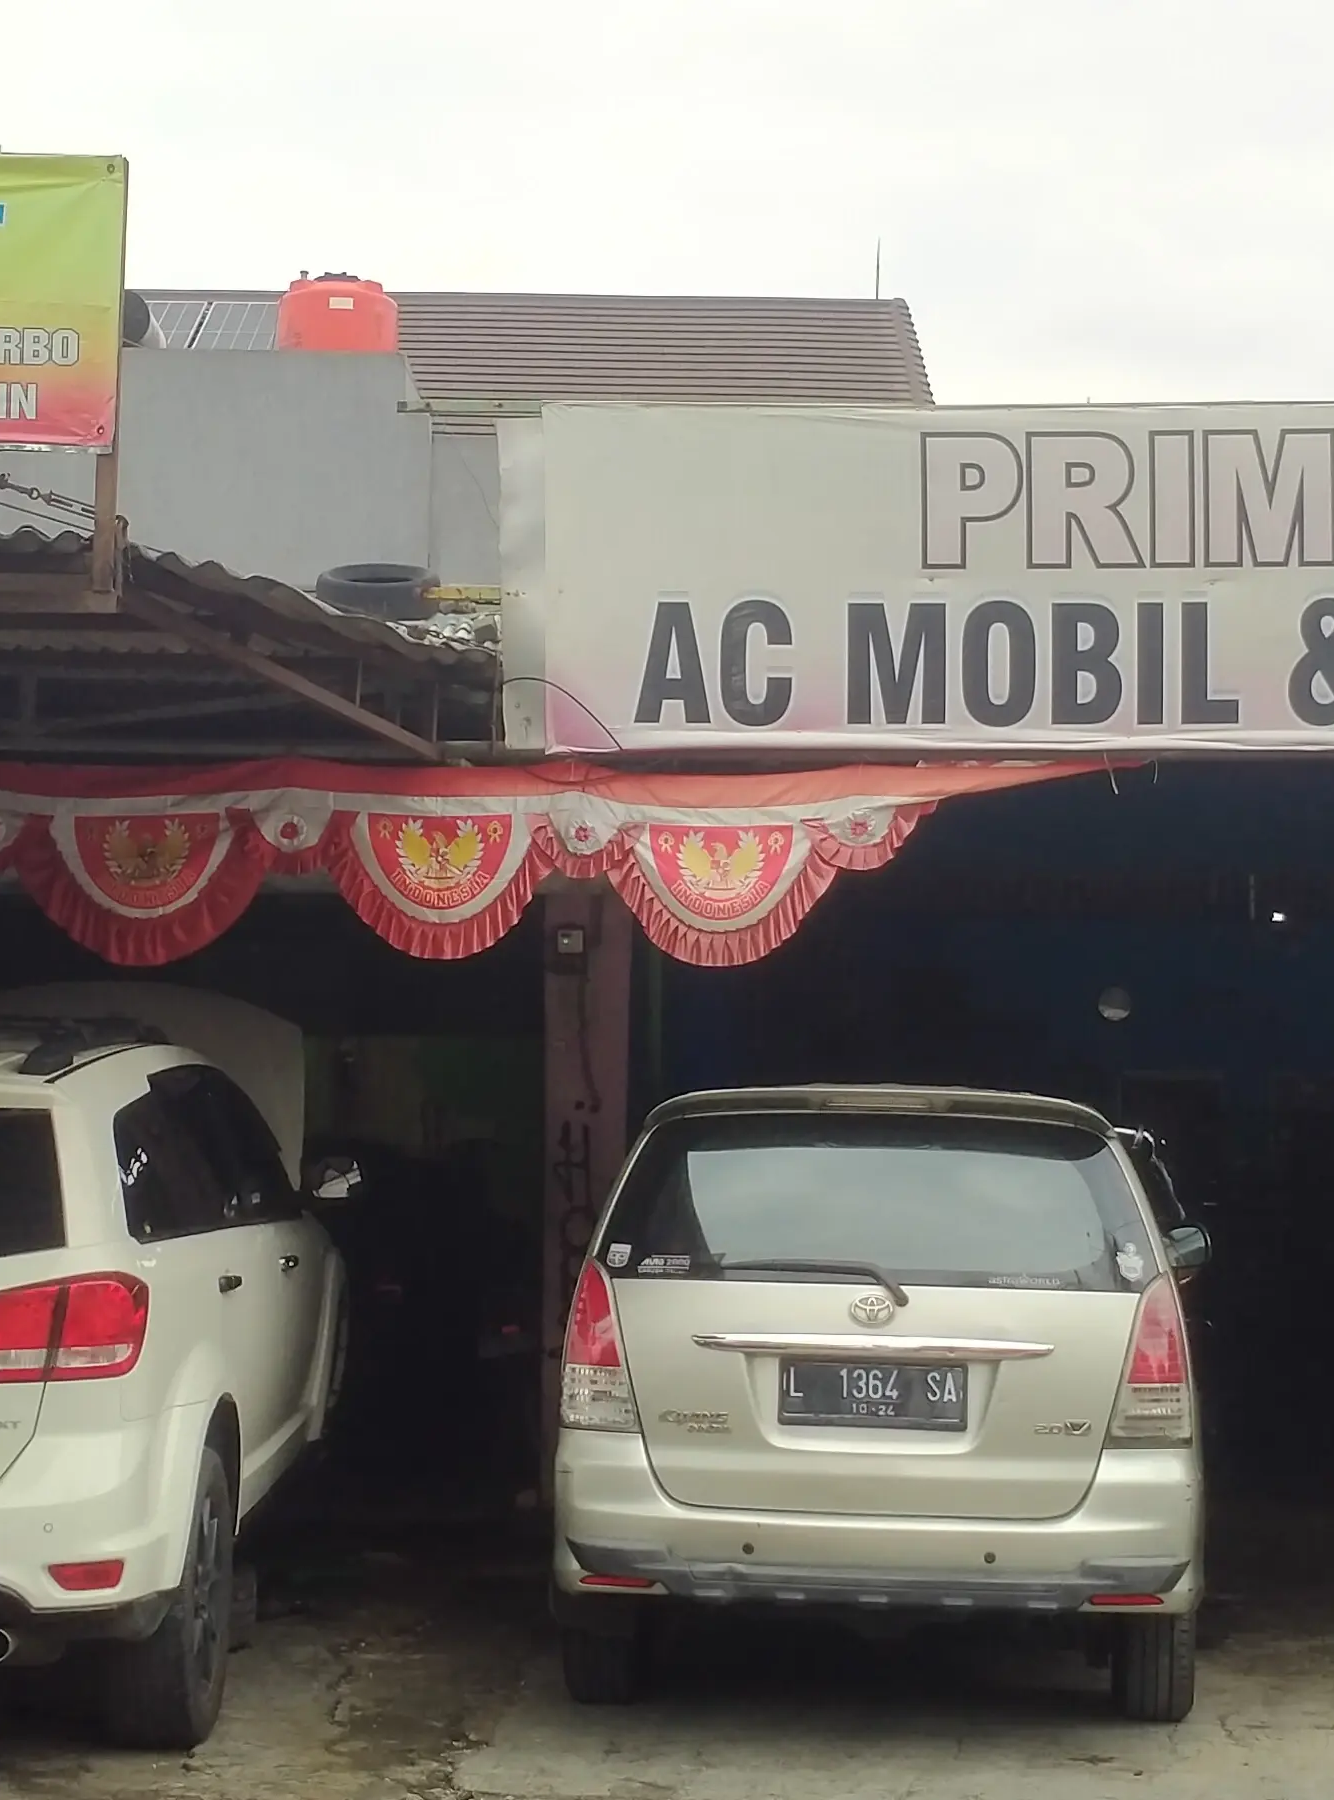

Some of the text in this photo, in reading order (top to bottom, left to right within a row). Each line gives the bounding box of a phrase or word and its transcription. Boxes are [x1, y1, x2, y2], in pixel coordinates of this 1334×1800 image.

[633, 598, 795, 728] AC
[846, 599, 1240, 727] MOBIL
[391, 868, 491, 907] INDONESIA
[671, 880, 771, 917] INDONESIA
[789, 1366, 958, 1403] L 1364 SA
